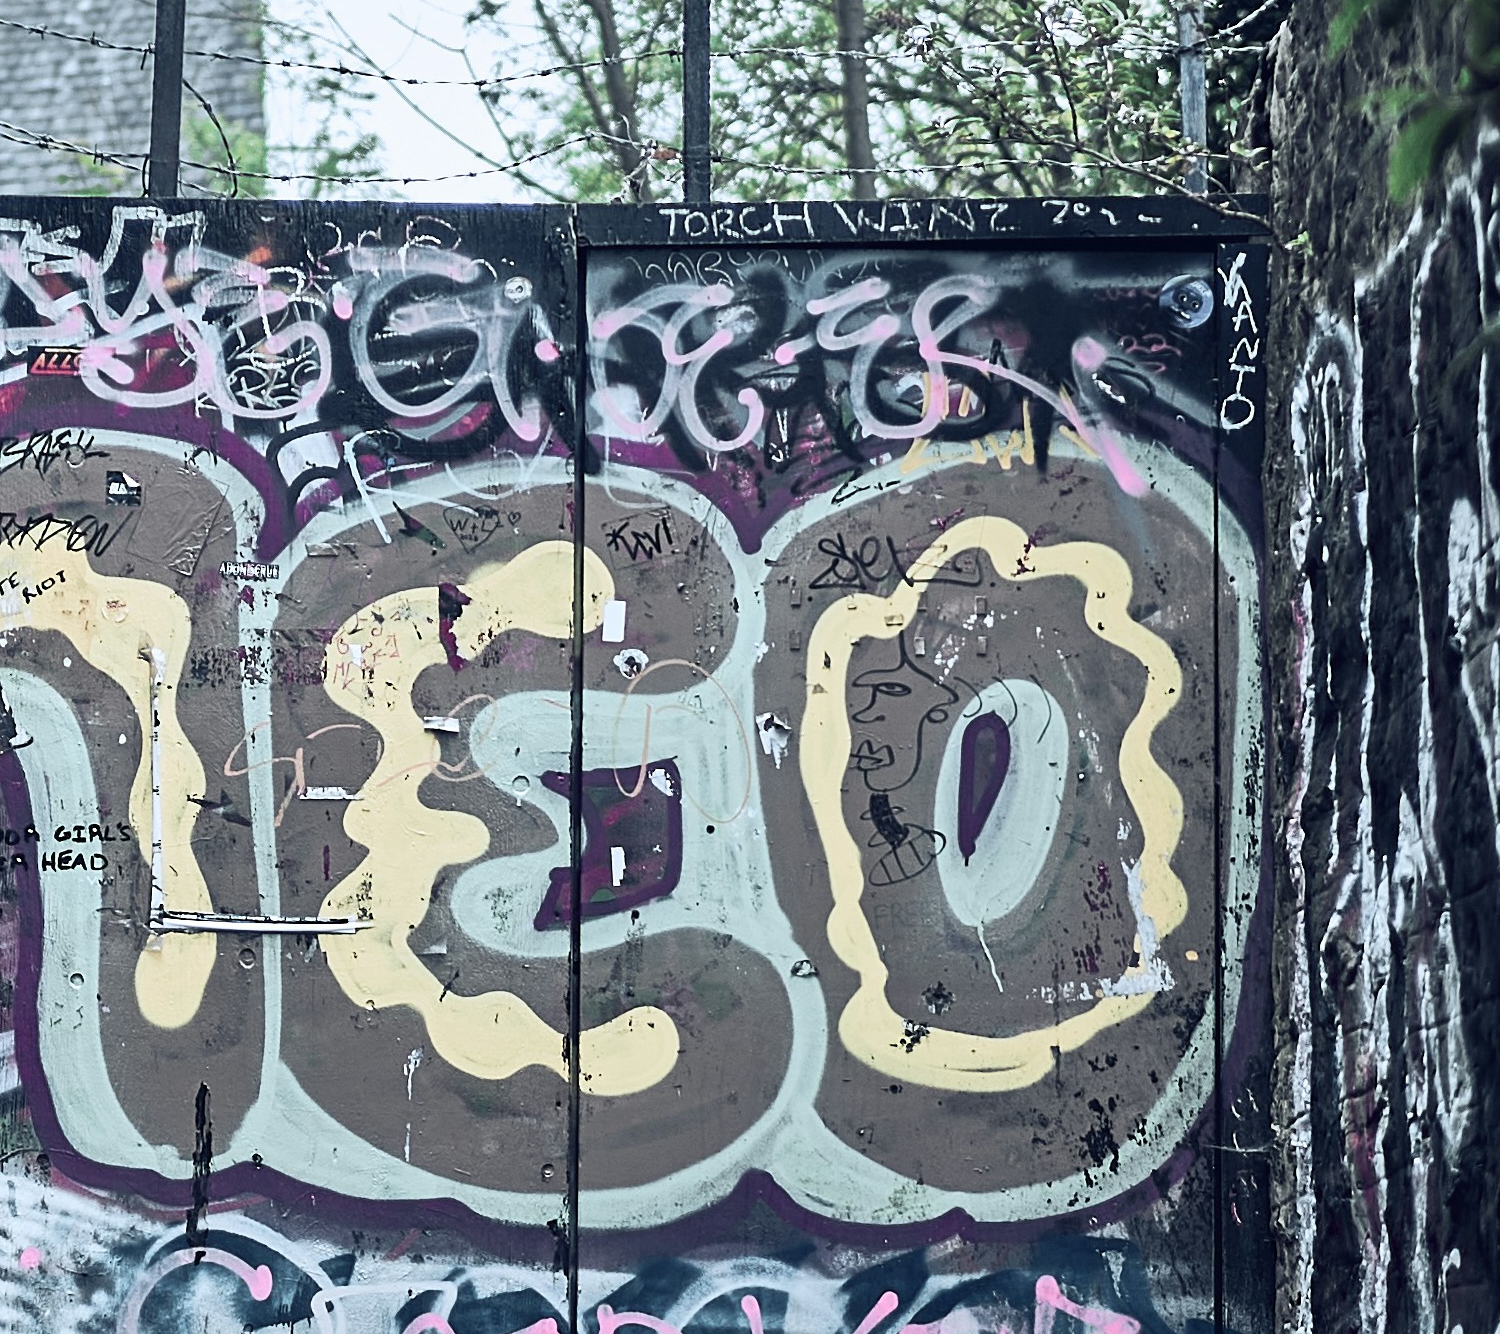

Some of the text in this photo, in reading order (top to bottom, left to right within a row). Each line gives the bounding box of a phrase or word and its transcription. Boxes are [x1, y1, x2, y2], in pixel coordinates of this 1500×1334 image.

[658, 202, 815, 239] TORCH
[22, 569, 67, 604] RIOT
[53, 822, 133, 843] GIRL'S
